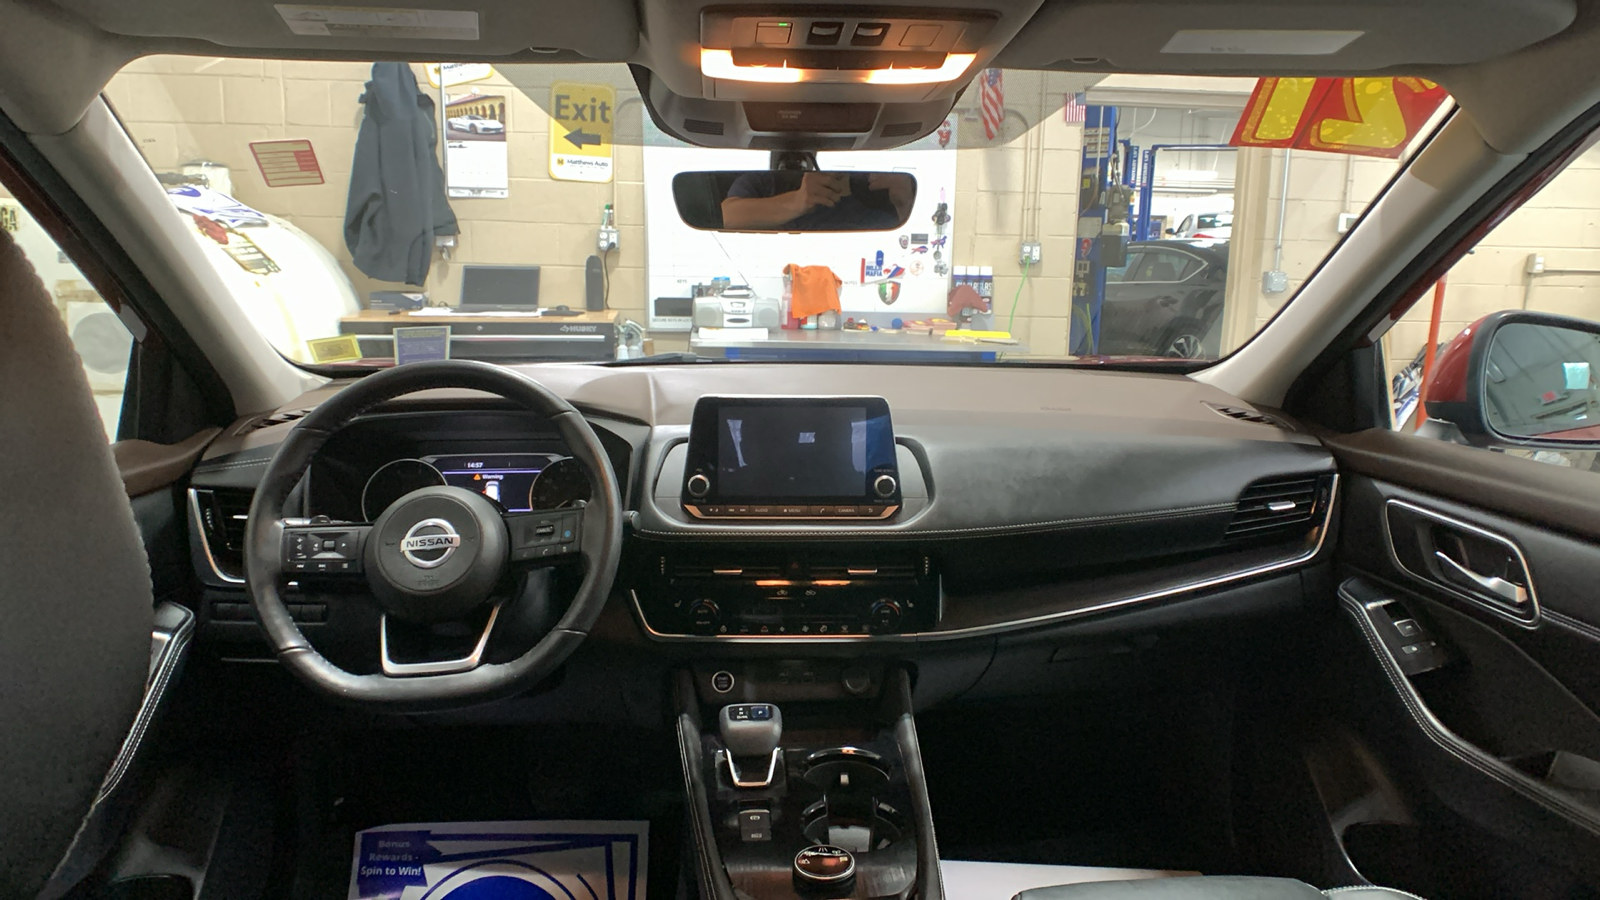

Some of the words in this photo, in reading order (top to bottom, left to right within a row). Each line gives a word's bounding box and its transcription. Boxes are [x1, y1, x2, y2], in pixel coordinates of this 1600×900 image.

[555, 94, 611, 124] Exit
[406, 537, 454, 548] NISSAN
[378, 840, 411, 848] Bonus
[369, 853, 413, 861] Rewards
[360, 866, 383, 877] Spin
[385, 867, 396, 876] to
[398, 866, 422, 876] Win!
